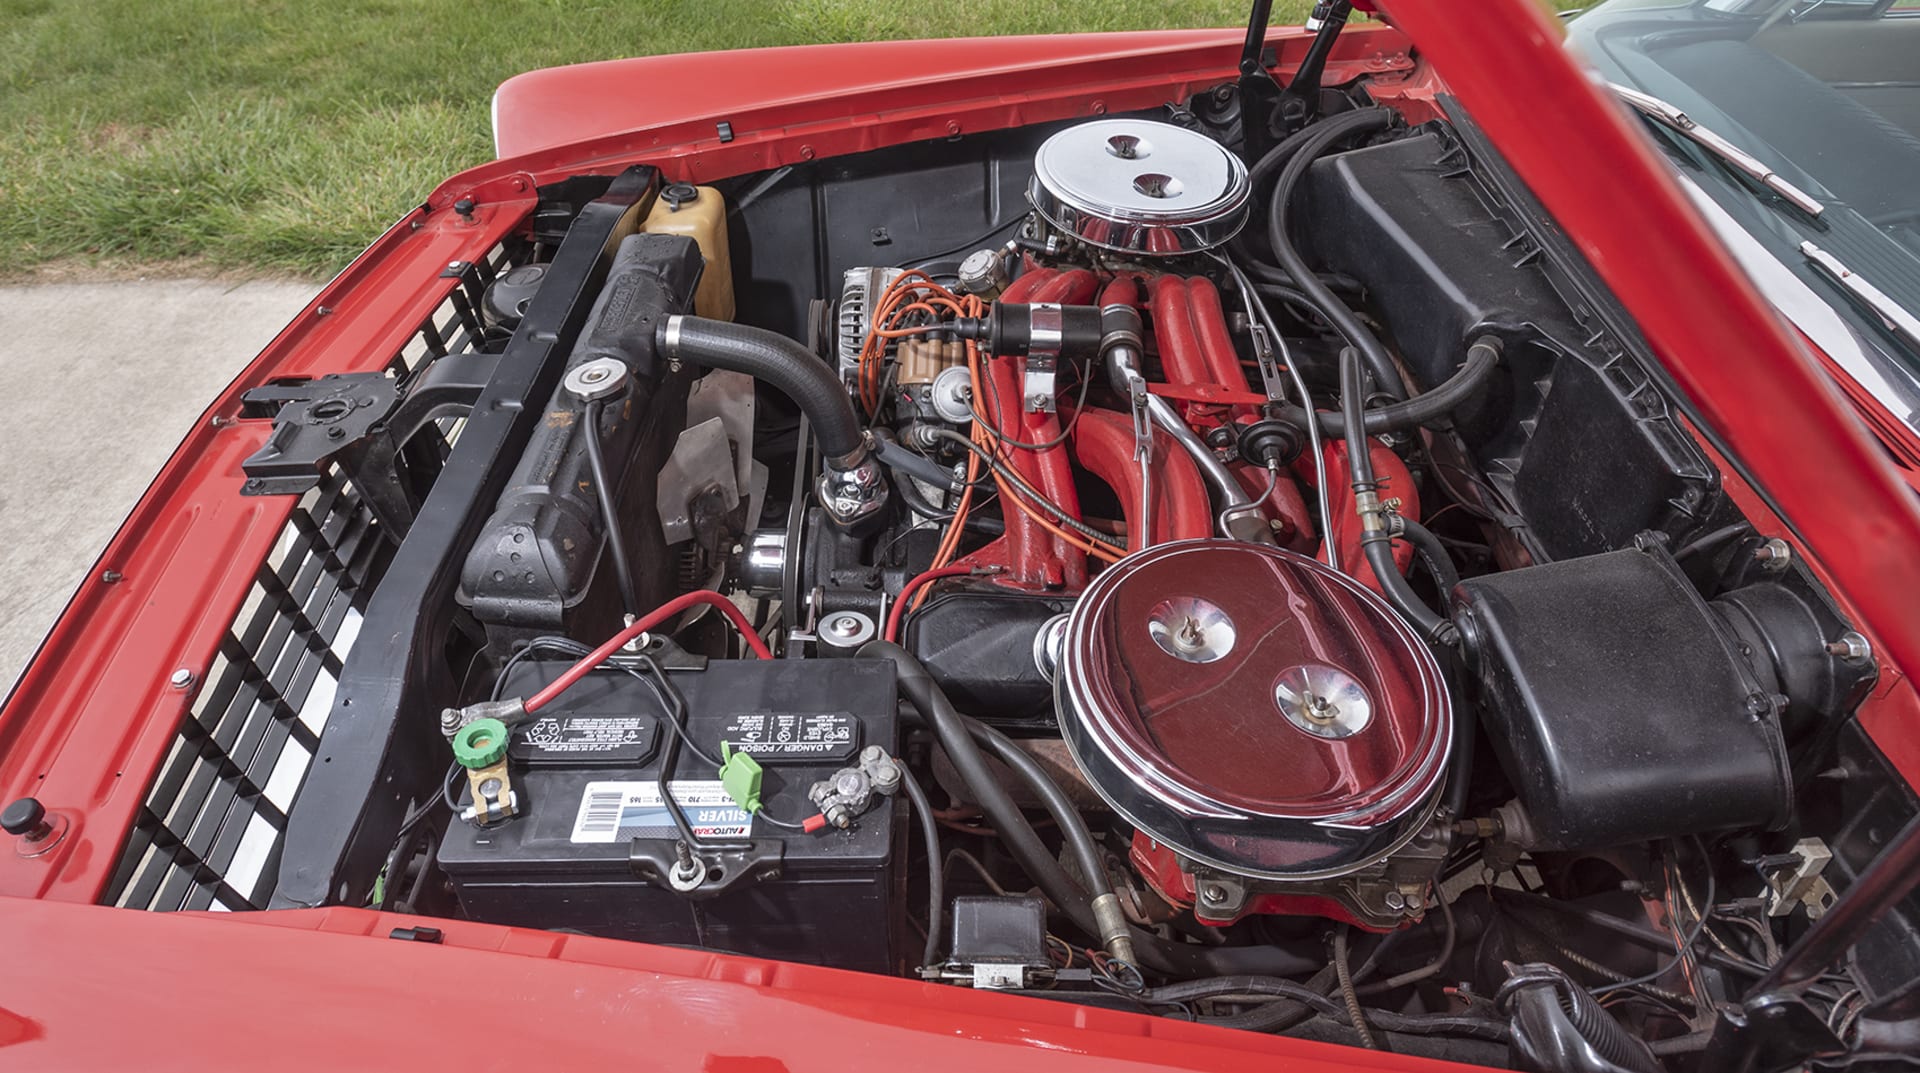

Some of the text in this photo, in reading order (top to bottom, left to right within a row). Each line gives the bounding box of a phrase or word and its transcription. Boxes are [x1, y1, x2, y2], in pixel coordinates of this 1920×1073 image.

[739, 744, 774, 752] POISON
[784, 744, 823, 752] DANGER
[698, 810, 748, 822] SILVER
[694, 826, 739, 835] AUTOCRA
